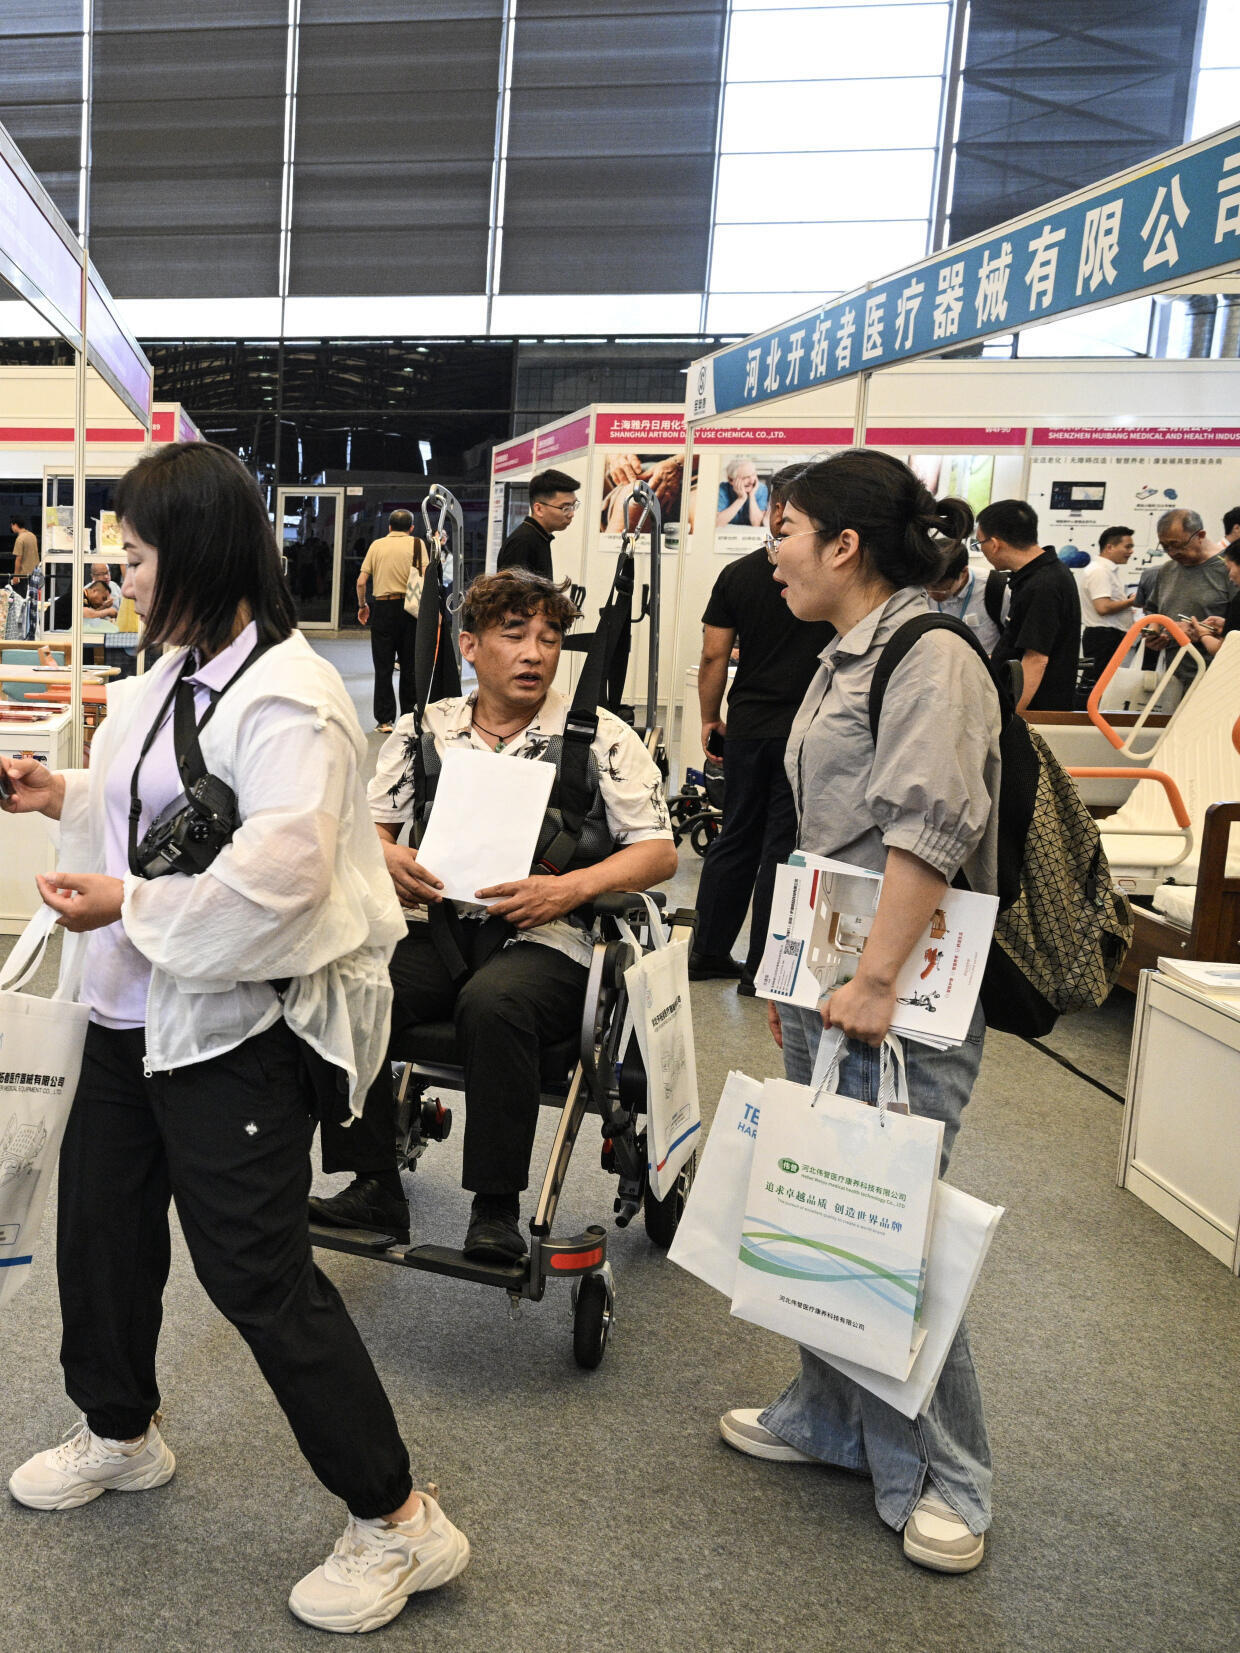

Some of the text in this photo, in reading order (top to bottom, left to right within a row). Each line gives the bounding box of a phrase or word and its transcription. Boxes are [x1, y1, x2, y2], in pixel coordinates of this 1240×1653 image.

[717, 431, 754, 439] CHEMICAL
[1048, 432, 1091, 440] SHENZHEN
[765, 1180, 903, 1233] 追求卓越品质 创造世界品牌
